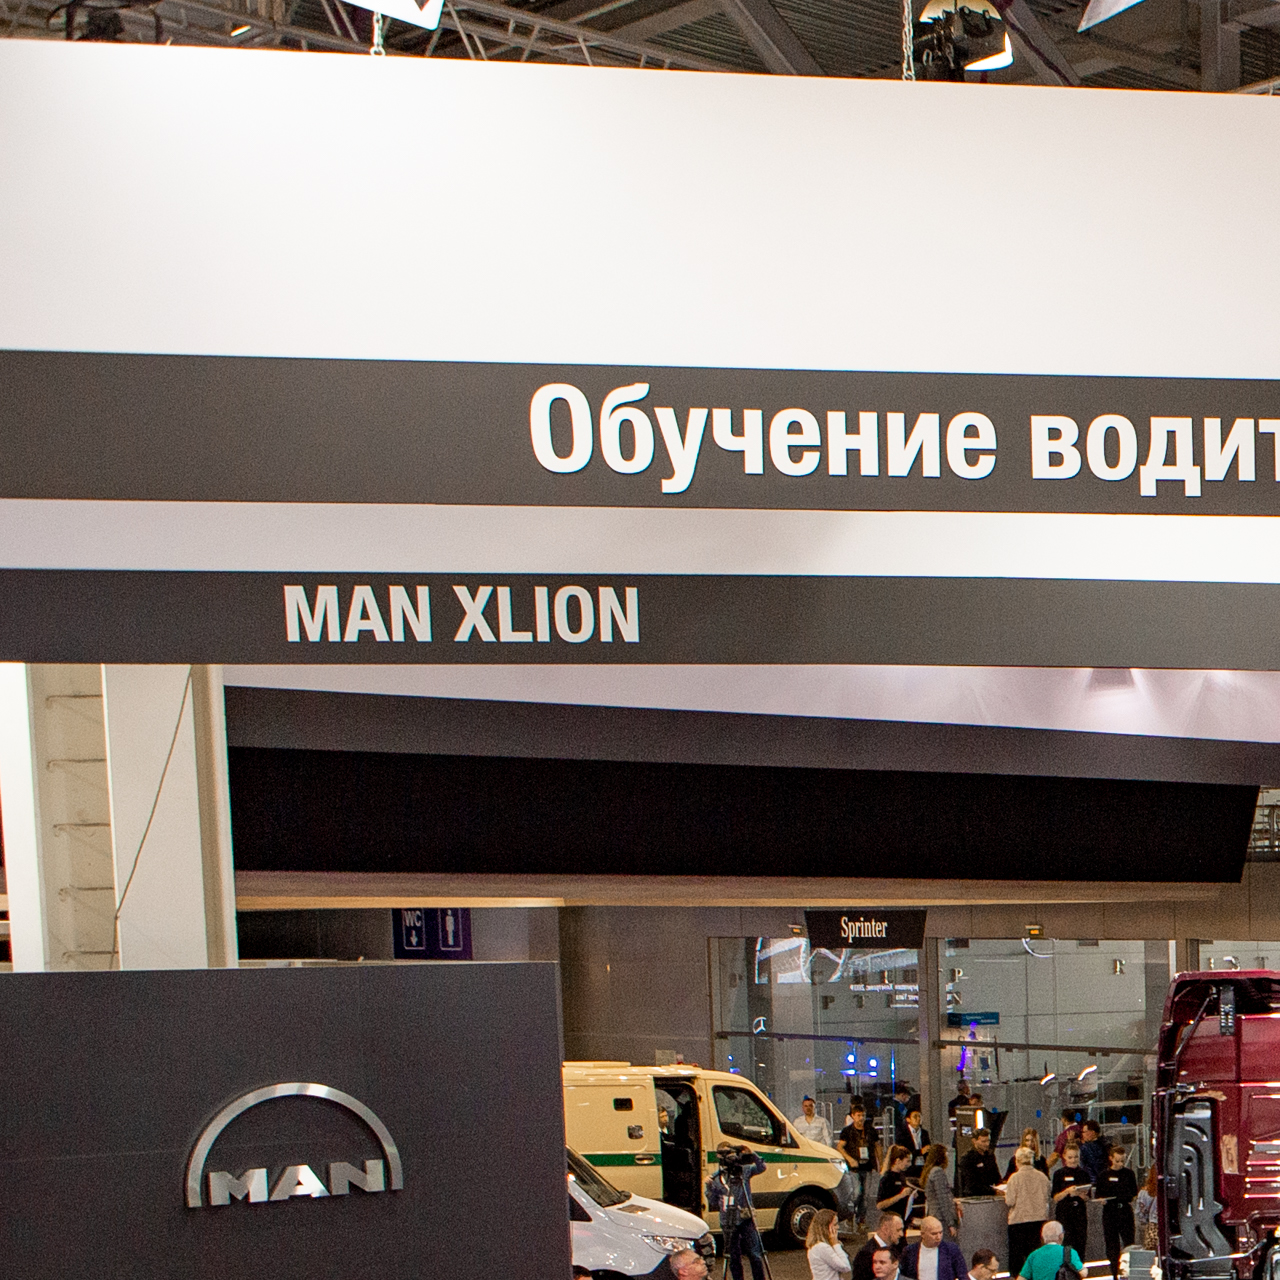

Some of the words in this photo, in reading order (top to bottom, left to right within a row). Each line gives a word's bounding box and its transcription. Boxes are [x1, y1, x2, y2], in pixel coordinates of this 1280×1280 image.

[528, 381, 998, 493] Обучение
[283, 584, 433, 642] MAN
[452, 584, 640, 643] XLION
[403, 910, 422, 927] WC
[840, 916, 888, 943] Sprinter
[208, 1159, 387, 1206] MAN
